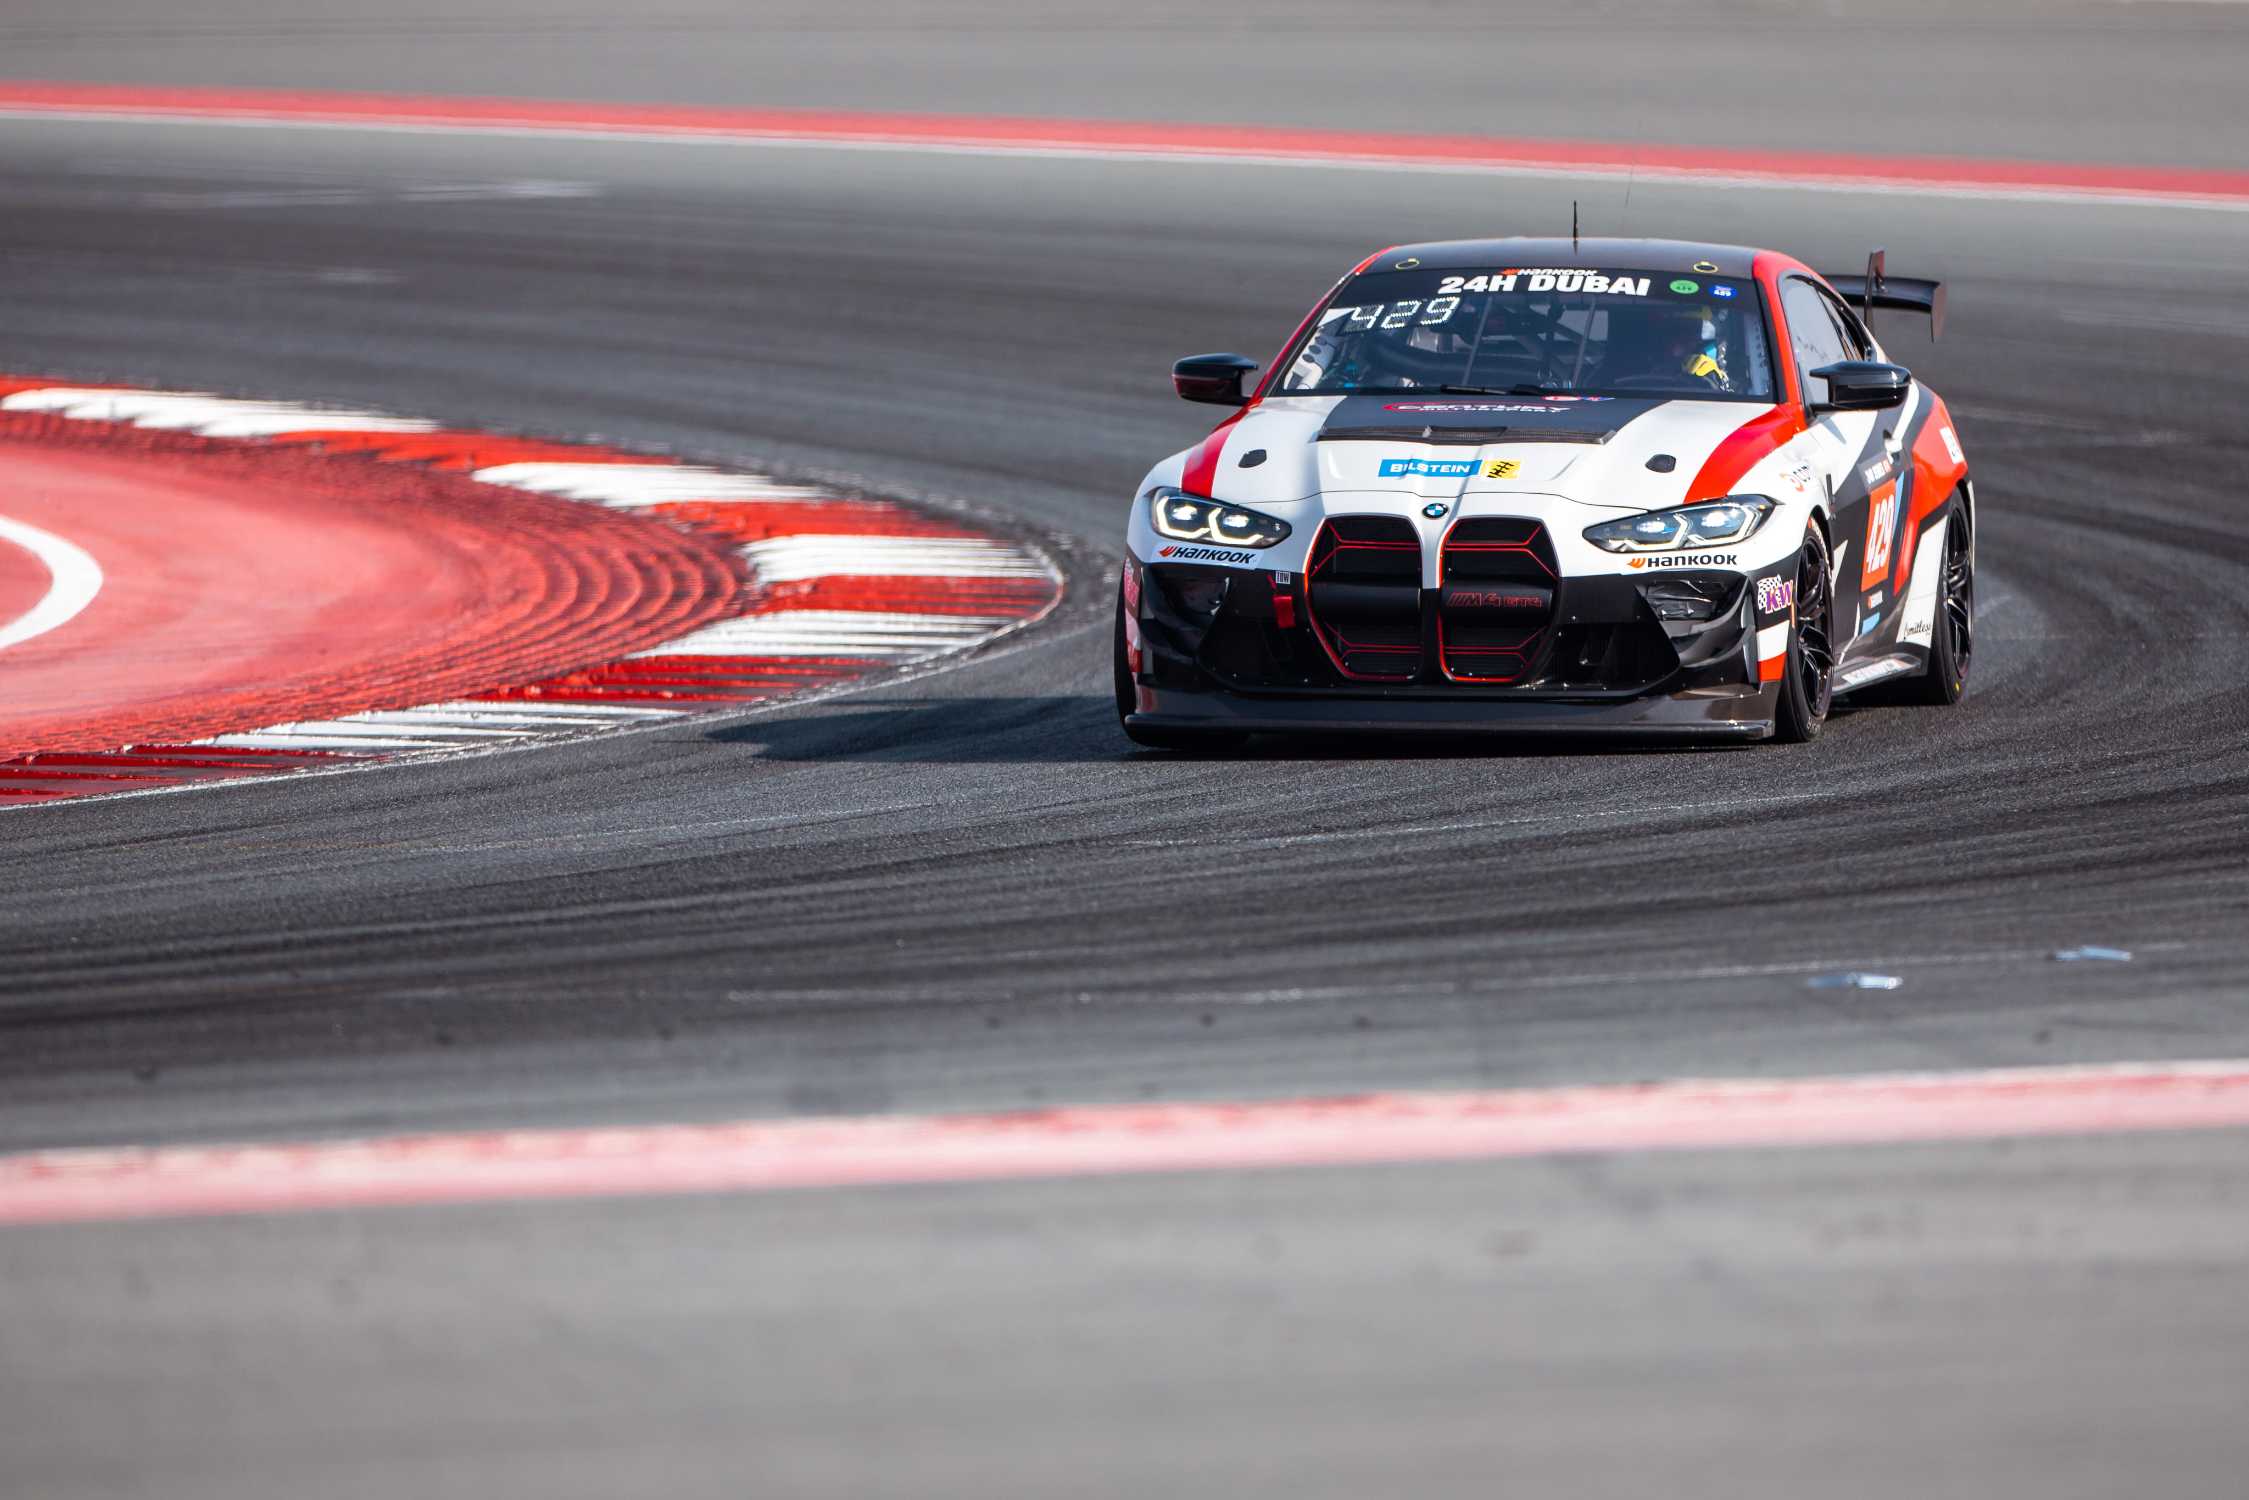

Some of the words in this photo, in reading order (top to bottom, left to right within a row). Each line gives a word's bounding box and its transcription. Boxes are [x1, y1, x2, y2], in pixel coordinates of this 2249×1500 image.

[1438, 275, 1516, 294] 24H
[1527, 275, 1651, 296] DUBAI
[1351, 297, 1461, 329] 429
[1390, 461, 1471, 473] BILSTEIN
[1866, 494, 1895, 574] 429
[1765, 581, 1793, 614] KW
